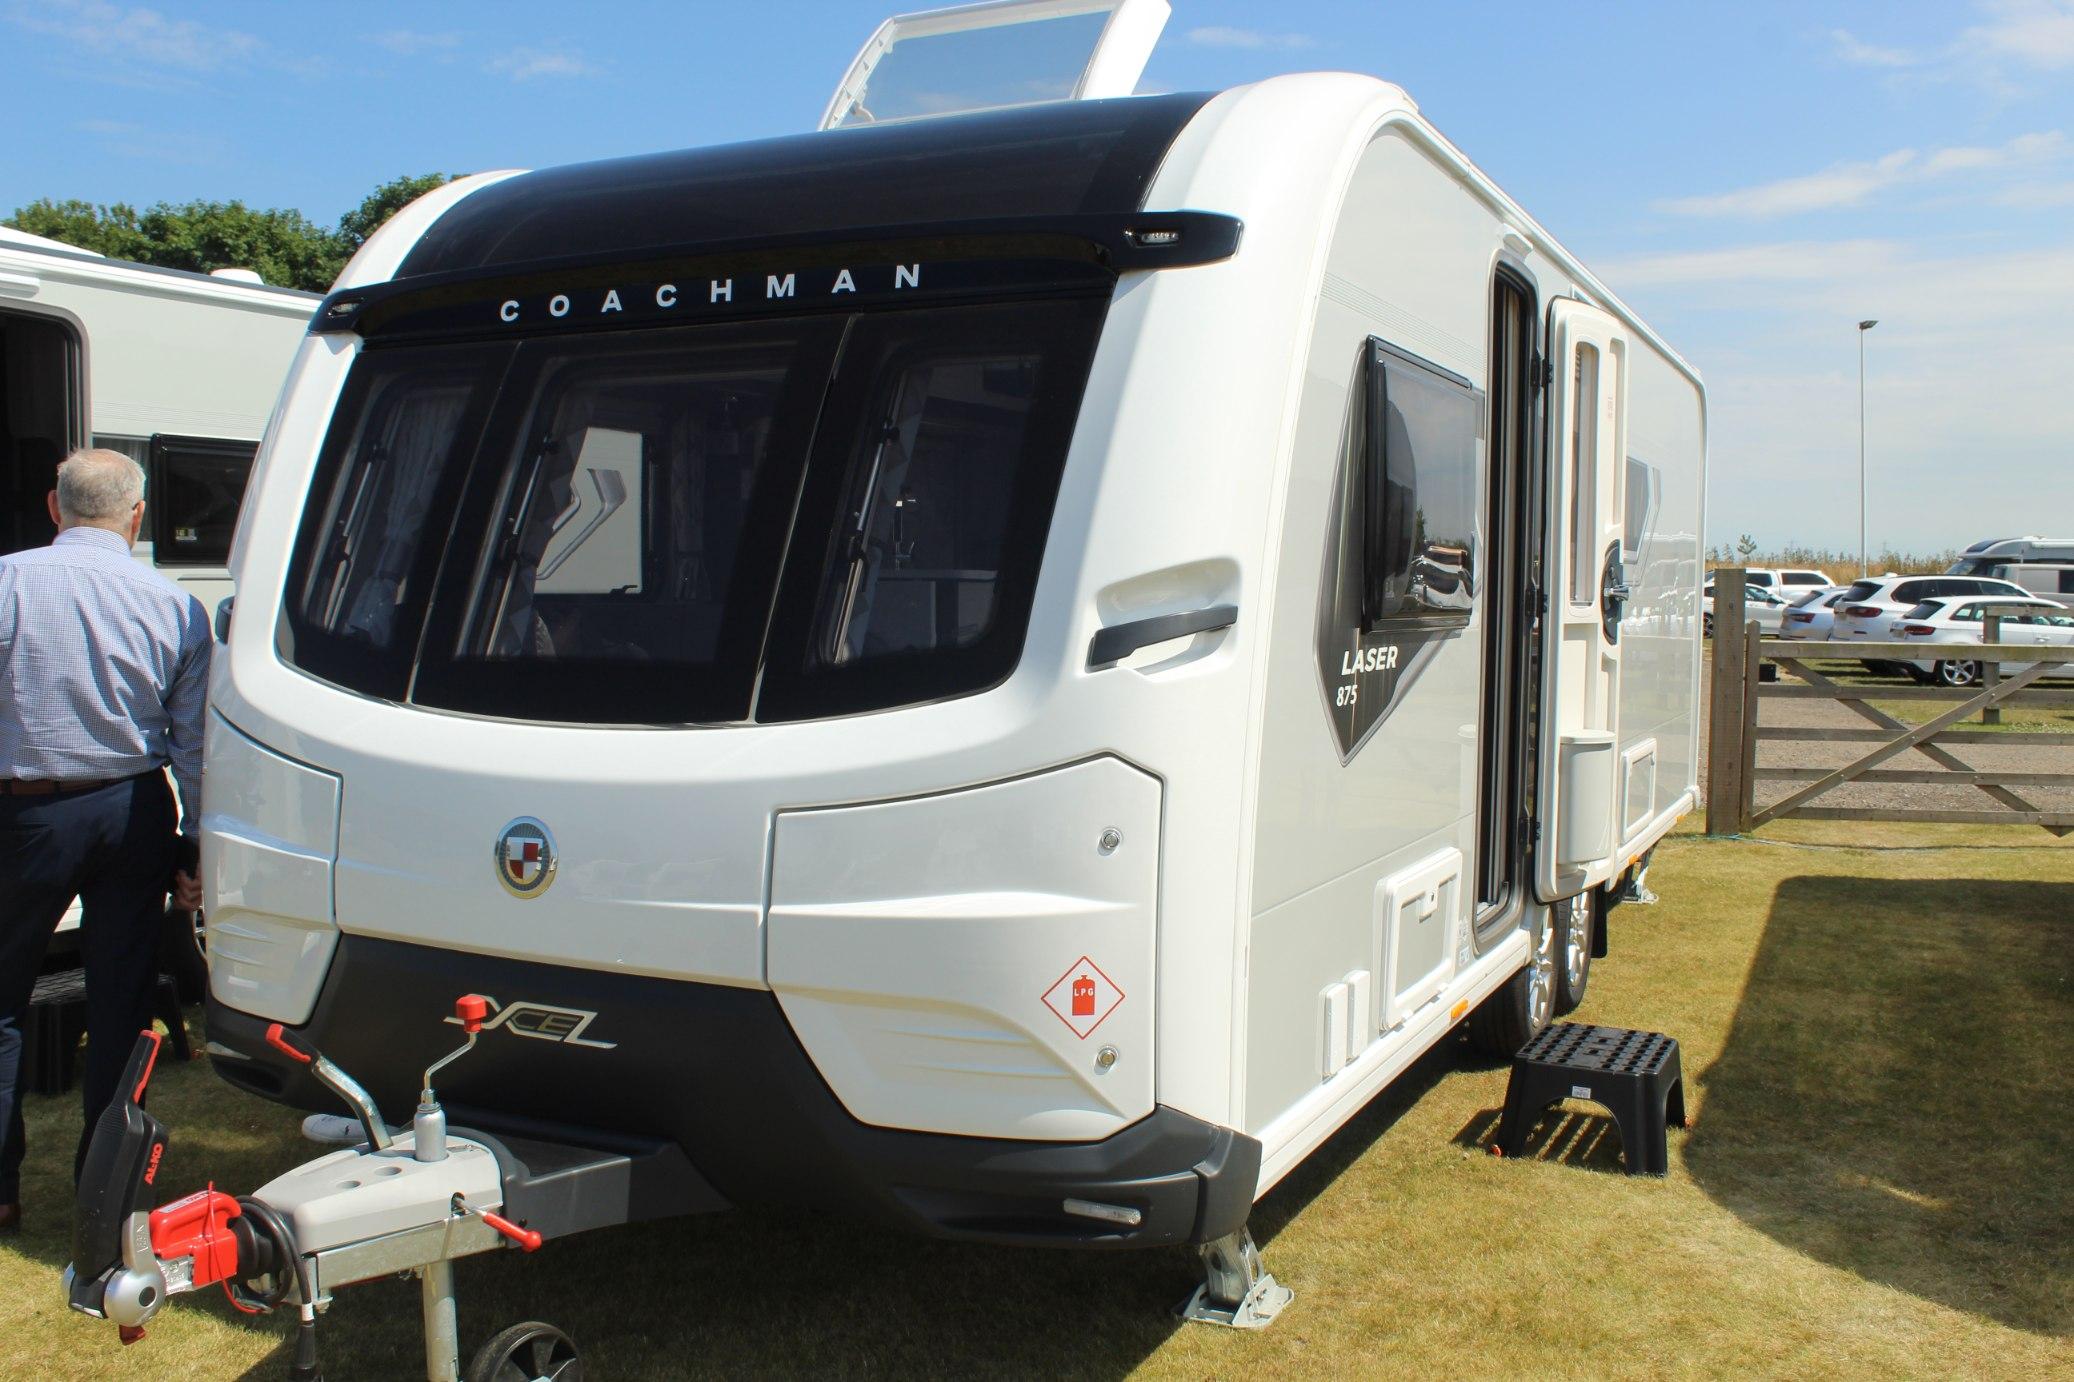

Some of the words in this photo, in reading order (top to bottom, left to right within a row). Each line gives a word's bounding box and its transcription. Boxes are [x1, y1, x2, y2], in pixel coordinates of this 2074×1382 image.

[500, 264, 921, 322] COACHMAN
[1341, 646, 1398, 675] LASER
[1336, 685, 1358, 707] 875
[1074, 988, 1094, 996] LPG
[144, 1143, 163, 1185] AL-KO
